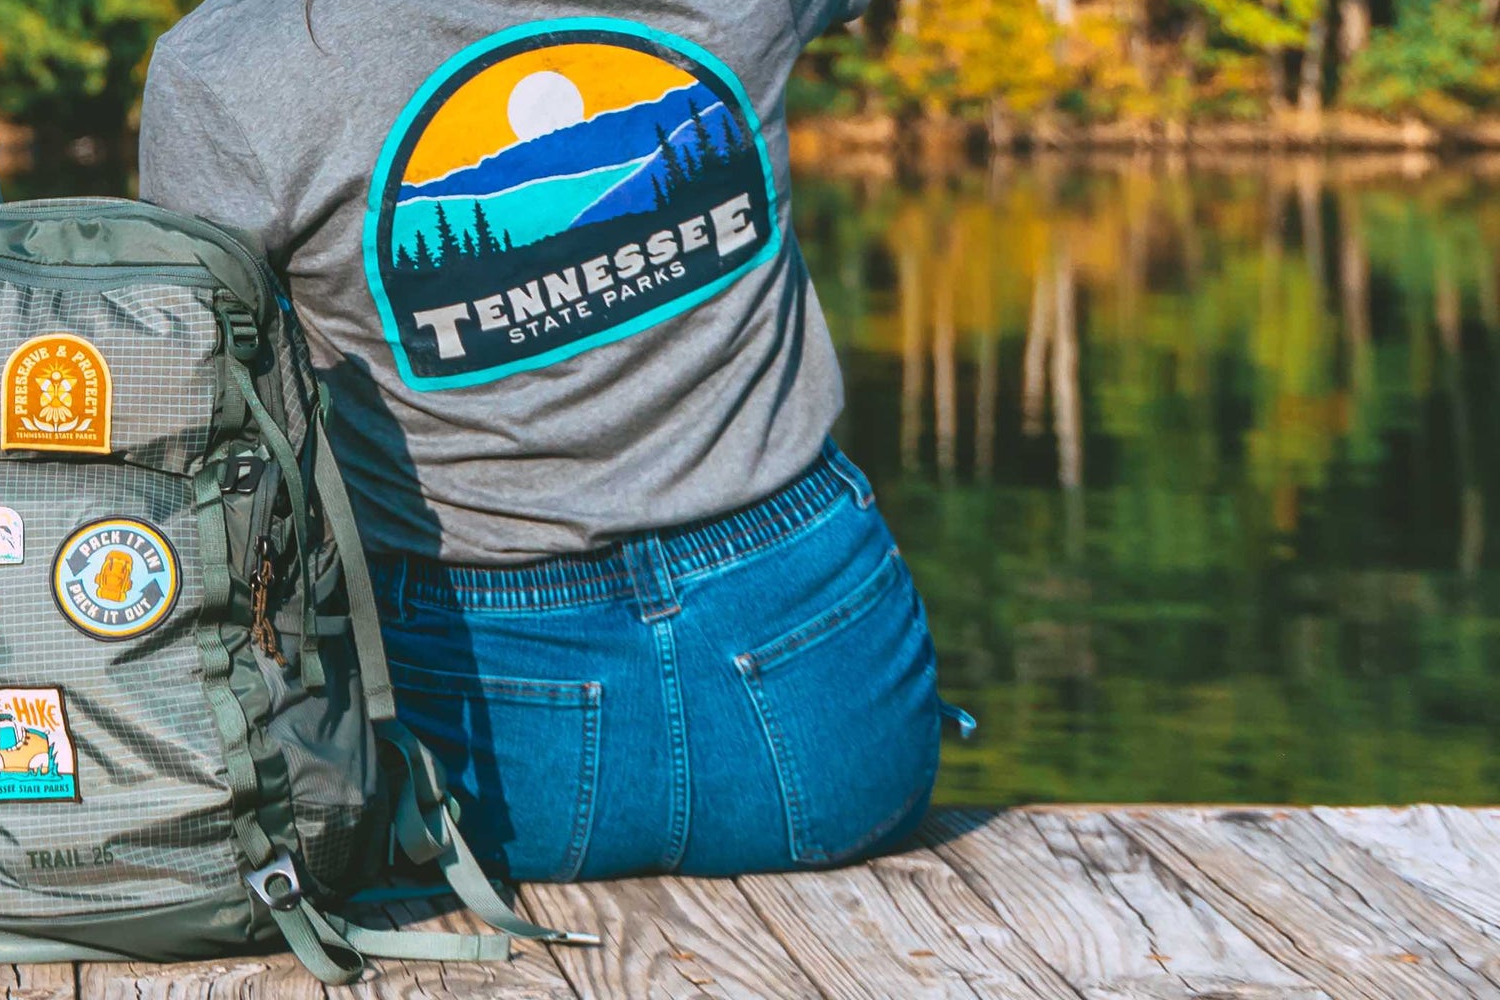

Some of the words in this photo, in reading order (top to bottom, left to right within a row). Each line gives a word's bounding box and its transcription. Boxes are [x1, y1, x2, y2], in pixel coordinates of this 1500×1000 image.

[412, 192, 758, 361] TENNESSEE
[509, 300, 593, 345] STATE
[602, 260, 686, 309] PARKS
[14, 347, 51, 416] PRESERVE
[55, 345, 67, 358] &
[71, 350, 99, 418] PROTECT
[15, 431, 53, 440] TENNESSEE
[54, 432, 73, 441] STATE
[75, 432, 98, 441] PARKS
[78, 530, 121, 558] PACK
[126, 532, 145, 550] IT
[143, 548, 161, 570] IN
[69, 583, 100, 620] PACK
[103, 610, 119, 624] IT
[124, 598, 152, 622] OUT
[12, 696, 60, 732] HIKE
[19, 784, 40, 794] STATE
[43, 783, 70, 793] PARKS
[26, 848, 86, 869] TRAIL
